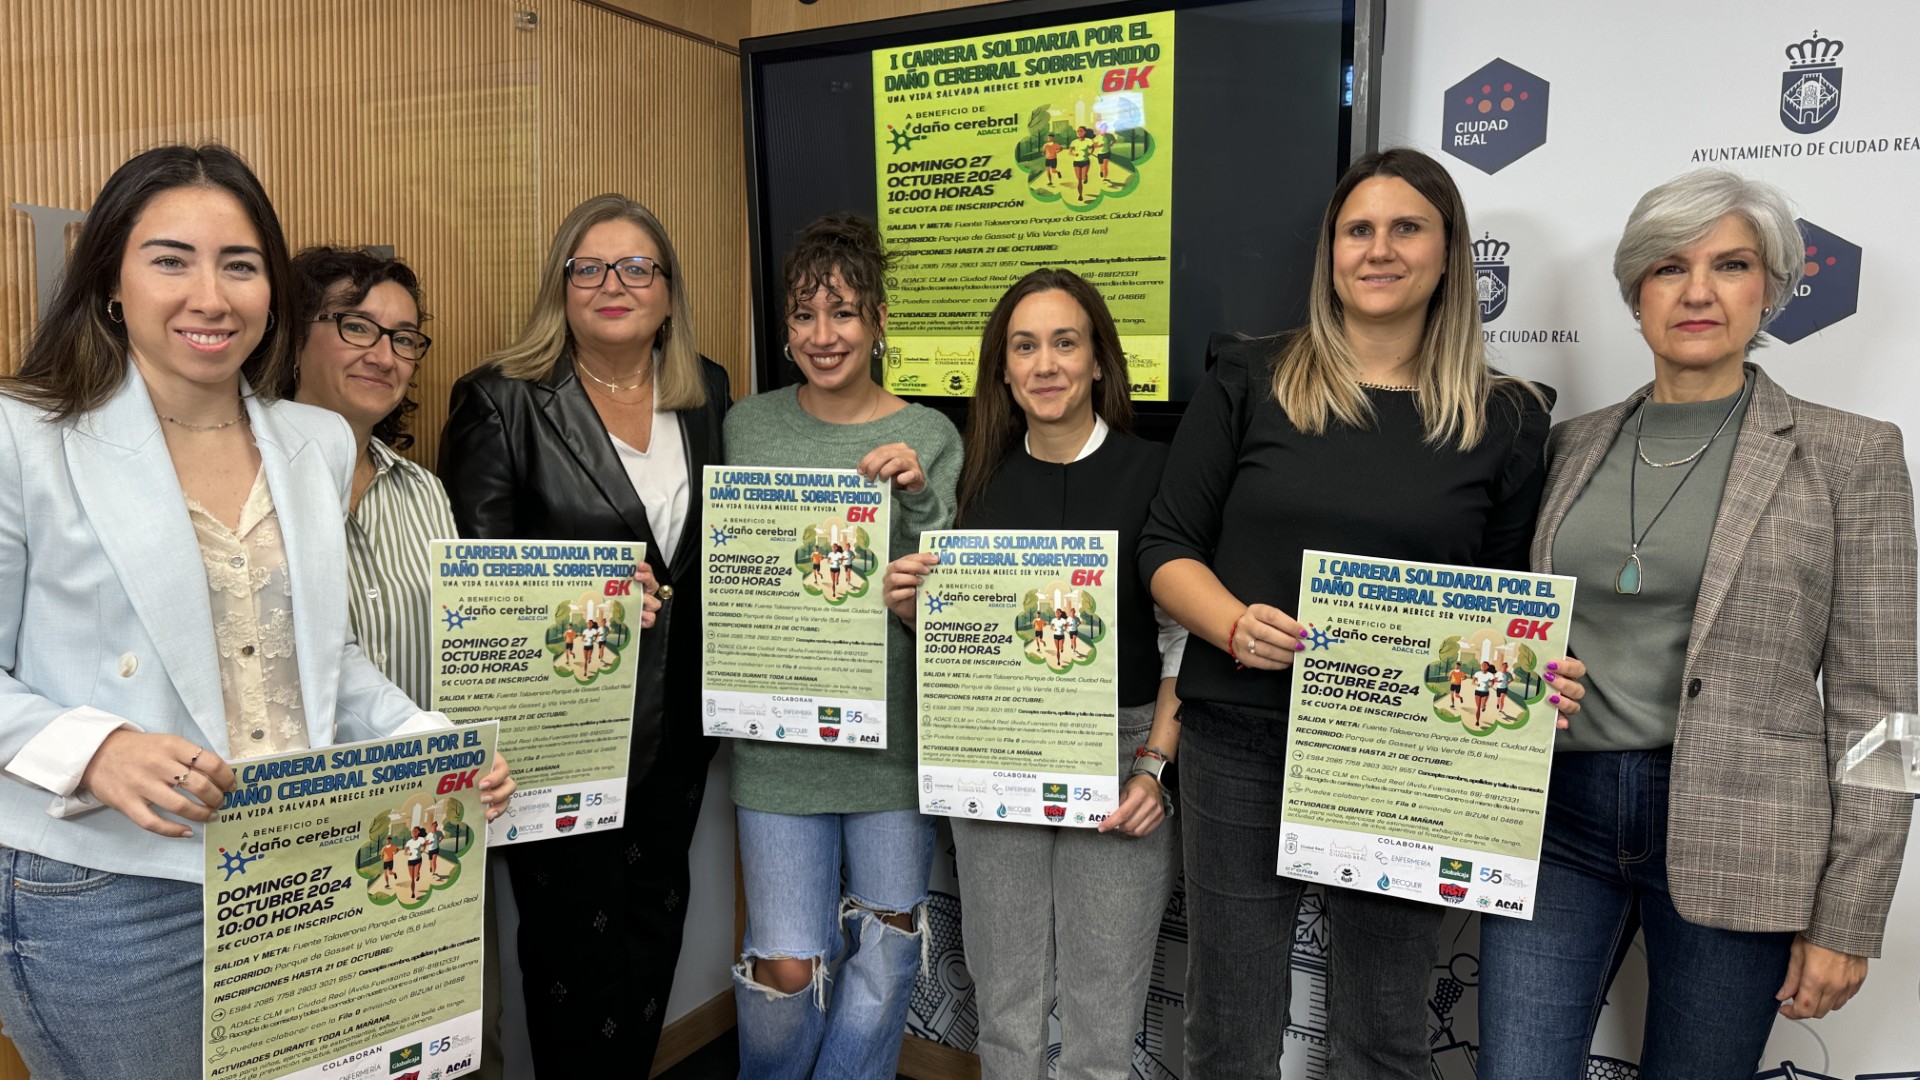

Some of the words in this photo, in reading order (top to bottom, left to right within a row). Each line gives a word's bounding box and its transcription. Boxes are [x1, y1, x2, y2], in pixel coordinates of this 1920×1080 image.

[889, 53, 898, 70] I
[902, 44, 976, 71] CARRERA
[982, 30, 1079, 58] SOLIDARIA
[1084, 24, 1123, 46] POR
[1129, 21, 1152, 40] EL
[884, 65, 929, 91] DAÑO
[934, 61, 1019, 85] CEREBRAL
[1025, 44, 1159, 75] SOBREVENIDO
[887, 94, 905, 103] UNA
[909, 91, 932, 101] VIDA
[936, 86, 979, 98] SALVADA
[983, 82, 1018, 92] MERECE
[1023, 80, 1040, 88] SER
[1045, 74, 1082, 85] VIVIDA
[1101, 65, 1154, 95] 6K
[911, 121, 950, 136] daño
[954, 113, 1017, 131] cerebral
[1455, 119, 1509, 134] CIUDAD
[1454, 133, 1488, 146] REAL
[1691, 143, 1802, 163] AYUNTAMIENTO
[1806, 142, 1825, 156] DE
[1829, 138, 1889, 154] CIUDAD
[1893, 136, 1920, 151] REA
[887, 157, 967, 173] DOMINGO
[969, 155, 992, 167] 27
[887, 172, 964, 187] OCTUBRE
[966, 168, 1012, 182] 2024
[887, 188, 931, 201] 10:00
[934, 184, 993, 198] HORAS
[902, 205, 937, 213] CUOTA
[955, 199, 1024, 210] INSCRIPCIÓN
[1482, 330, 1496, 343] DE
[1500, 330, 1548, 343] CIUDAD
[1552, 330, 1580, 343] REAL
[714, 471, 719, 484] I
[722, 471, 771, 486] CARRERA
[774, 473, 834, 487] SOLIDARIA
[837, 473, 861, 488] POR
[709, 482, 740, 500] DAÑO
[743, 488, 797, 502] CEREBRAL
[801, 489, 881, 504] SOBREVENIDO
[846, 506, 877, 522] 6K
[727, 525, 752, 536] daño
[755, 527, 796, 538] cerebral
[930, 536, 936, 549] I
[939, 536, 990, 549] CARRERA
[993, 536, 1057, 549] SOLIDARIA
[1061, 536, 1085, 550] POR
[1089, 536, 1104, 549] EL
[445, 545, 452, 559] I
[455, 545, 517, 560] CARRERA
[521, 546, 590, 560] SOLIDARIA
[593, 546, 617, 560] POR
[621, 547, 634, 560] EL
[709, 553, 764, 563] DOMINGO
[765, 555, 779, 564] 27
[959, 552, 1018, 566] CEREBRAL
[1022, 552, 1108, 567] SOBREVENIDO
[440, 557, 479, 577] DAÑO
[482, 563, 549, 577] CEREBRAL
[709, 564, 762, 574] OCTUBRE
[763, 566, 792, 575] 2024
[709, 575, 739, 584] 10:00
[741, 576, 780, 586] HORAS
[1071, 569, 1104, 586] 6K
[1318, 558, 1326, 574] I
[1330, 560, 1400, 582] CARRERA
[1405, 568, 1492, 591] SOLIDARIA
[1497, 577, 1530, 595] POR
[1535, 581, 1555, 598] EL
[604, 580, 632, 596] 6K
[1311, 572, 1353, 596] DAÑO
[1358, 583, 1436, 605] CEREBRAL
[1442, 592, 1559, 618] SOBREVENIDO
[943, 592, 969, 602] daño
[972, 593, 1016, 604] cerebral
[464, 604, 496, 615] daño
[499, 605, 548, 617] cerebral
[1312, 596, 1328, 605] UNA
[1333, 599, 1353, 608] VIDA
[1358, 602, 1398, 613] SALVADA
[1402, 607, 1434, 617] MERECE
[1438, 611, 1453, 619] SER
[1458, 613, 1491, 623] VIVIDA
[924, 621, 982, 631] DOMINGO
[982, 622, 998, 631] 27
[1506, 618, 1552, 640] 6K
[442, 637, 509, 648] DOMINGO
[510, 637, 528, 647] 27
[924, 632, 980, 643] OCTUBRE
[980, 634, 1012, 644] 2024
[1332, 627, 1367, 640] daño
[1371, 634, 1430, 648] cerebral
[441, 650, 506, 661] OCTUBRE
[508, 648, 542, 659] 2024
[924, 644, 956, 653] 10:00
[958, 644, 1000, 654] HORAS
[441, 663, 479, 674] 10:00
[481, 661, 528, 672] HORAS
[1304, 658, 1380, 676] DOMINGO
[1381, 668, 1402, 679] 27
[1303, 670, 1376, 689] OCTUBRE
[1378, 681, 1419, 695] 2024
[1301, 684, 1343, 697] 10:00
[1345, 689, 1401, 706] HORAS
[1314, 700, 1347, 710] CUOTA
[1364, 707, 1427, 721] INSCRIPCIÓN
[1295, 727, 1345, 738] RECORRIDO:
[242, 754, 325, 784] CARRERA
[331, 740, 421, 768] SOLIDARIA
[427, 733, 456, 753] POR
[463, 730, 479, 747] EL
[278, 770, 366, 799] CEREBRAL
[372, 749, 484, 783] SOBREVENIDO
[436, 768, 478, 794] 6K
[221, 811, 241, 822] UNA
[247, 806, 273, 817] VIDA
[279, 798, 324, 812] SALVADA
[330, 790, 364, 803] MERECE
[368, 787, 384, 796] SER
[389, 780, 422, 792] VIVIDA
[248, 837, 292, 858] daño
[296, 821, 360, 844] cerebral
[1377, 837, 1433, 850] COLABORAN
[1441, 868, 1469, 878] Globalcaja
[217, 872, 311, 904] DOMINGO
[311, 865, 336, 885] 27
[217, 888, 308, 920] OCTUBRE
[307, 876, 352, 902] 2024
[217, 913, 267, 938] 10:00
[271, 896, 334, 923] HORAS
[234, 931, 273, 947] CUOTA
[276, 925, 291, 936] DE
[293, 907, 363, 931] INSCRIPCIÓN
[214, 976, 288, 1003] INSCRIPCIONES
[291, 966, 322, 981] HASTA
[324, 963, 334, 971] 21
[336, 958, 350, 967] DE
[351, 946, 393, 963] OCTUBRE:
[321, 1046, 381, 1070] COLABORAN
[391, 1056, 419, 1069] Globalcaja
